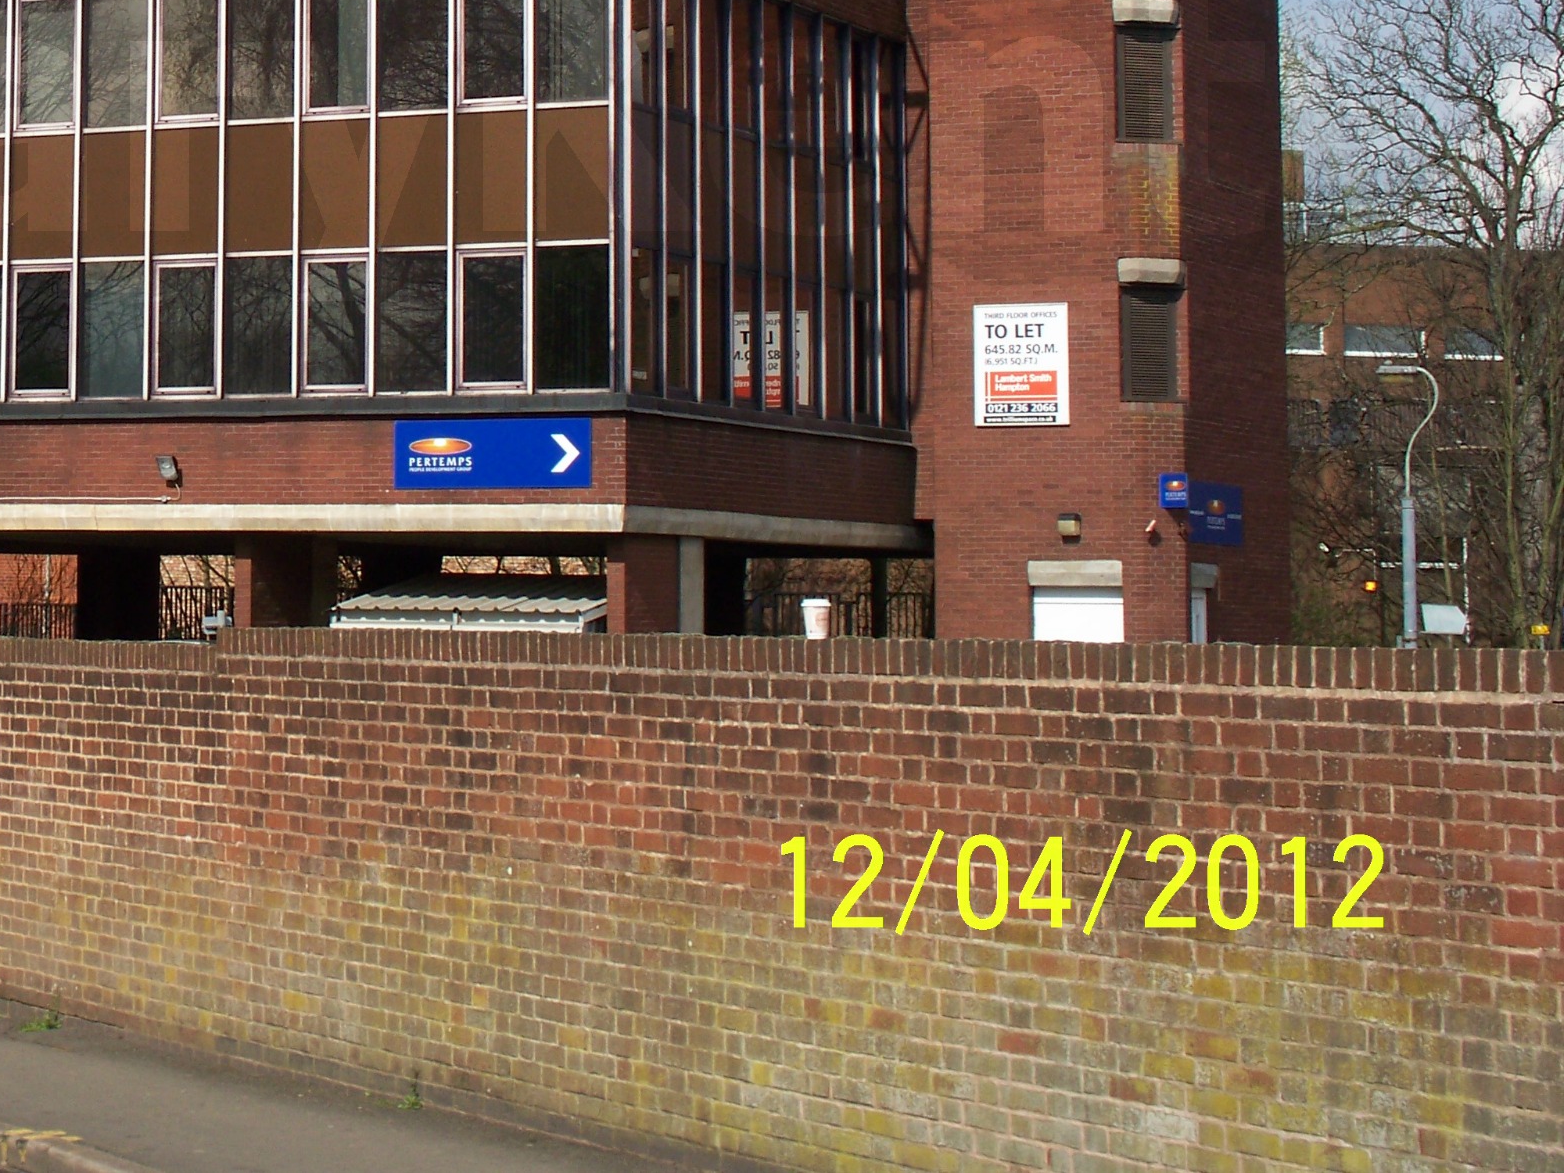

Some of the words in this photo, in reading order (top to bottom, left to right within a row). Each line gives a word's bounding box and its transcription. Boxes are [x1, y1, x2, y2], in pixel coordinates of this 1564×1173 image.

[984, 324, 1007, 339] TO
[1015, 323, 1044, 338] LET
[984, 345, 1021, 354] 645.82
[1025, 344, 1058, 355] SQ.M.
[995, 375, 1028, 383] Lambert
[1029, 374, 1052, 382] Smith
[995, 383, 1030, 392] Hampton
[987, 404, 1008, 413] 0121
[1010, 403, 1029, 413] 236
[1031, 403, 1056, 412] 2066
[408, 457, 472, 467] PERTEMPS
